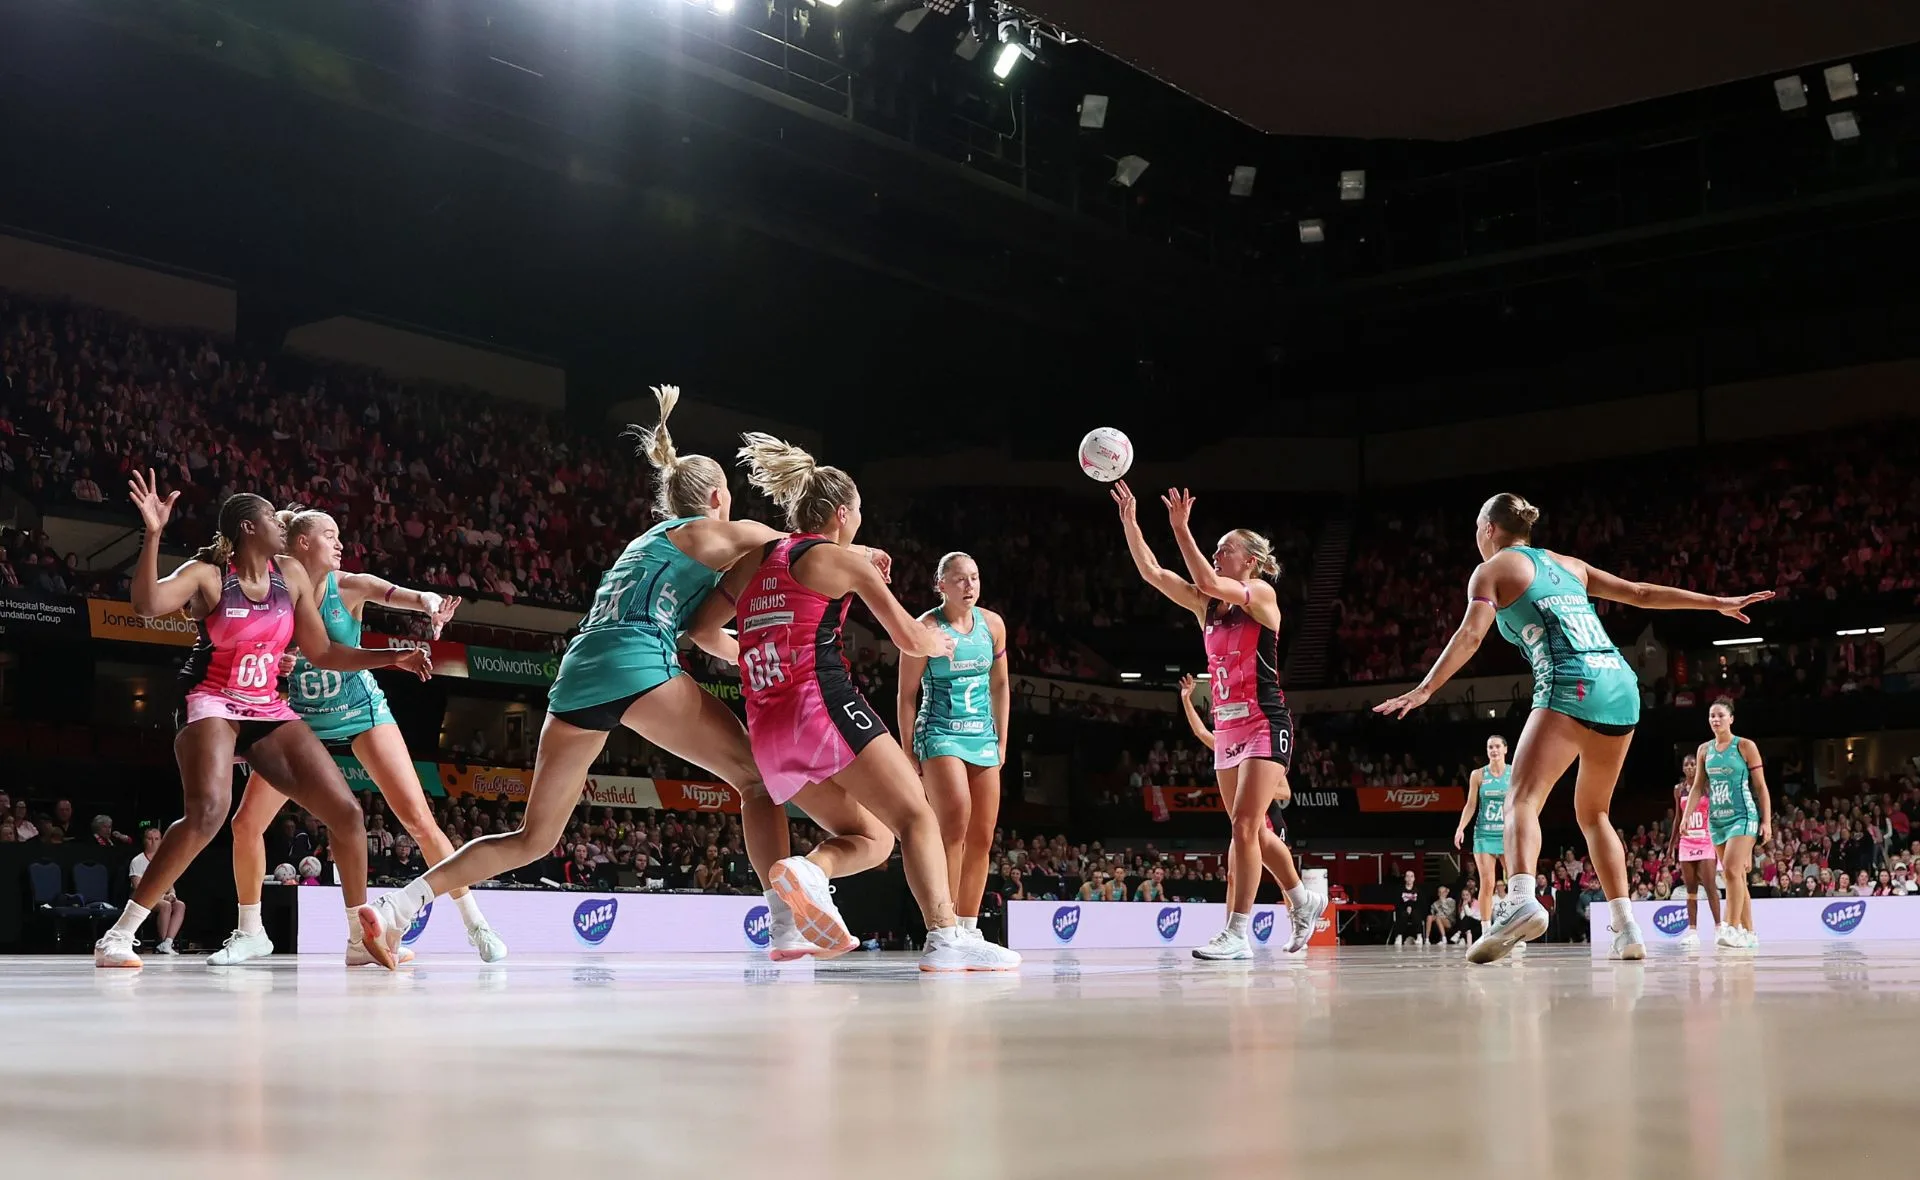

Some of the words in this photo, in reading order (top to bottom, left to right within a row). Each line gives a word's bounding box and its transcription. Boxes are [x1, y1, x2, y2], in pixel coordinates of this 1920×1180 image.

[762, 577, 777, 590] 100
[5, 599, 39, 611] Hospital
[40, 602, 76, 615] Research
[750, 594, 786, 612] HORJUS
[1537, 594, 1588, 610] MOLONE
[0, 611, 36, 621] undation
[37, 612, 61, 625] Group
[237, 653, 274, 688] GS
[473, 655, 542, 676] Woolworths
[743, 642, 785, 692] GA
[300, 669, 342, 699] GD
[1216, 667, 1230, 700] C
[964, 682, 980, 714] C
[843, 701, 873, 730] 5
[1279, 729, 1289, 753] 6
[582, 777, 637, 804] Westfield
[682, 784, 731, 808] Nippy's
[1293, 792, 1339, 807] VALOUR
[1385, 789, 1440, 808] Nippy's
[580, 903, 613, 932] JAZZ
[750, 912, 770, 936] JAZ
[1056, 909, 1078, 932] JAZZ
[1160, 910, 1180, 932] JAZZ
[1659, 905, 1689, 928] JAZZ
[1829, 903, 1862, 926] JAZZ
